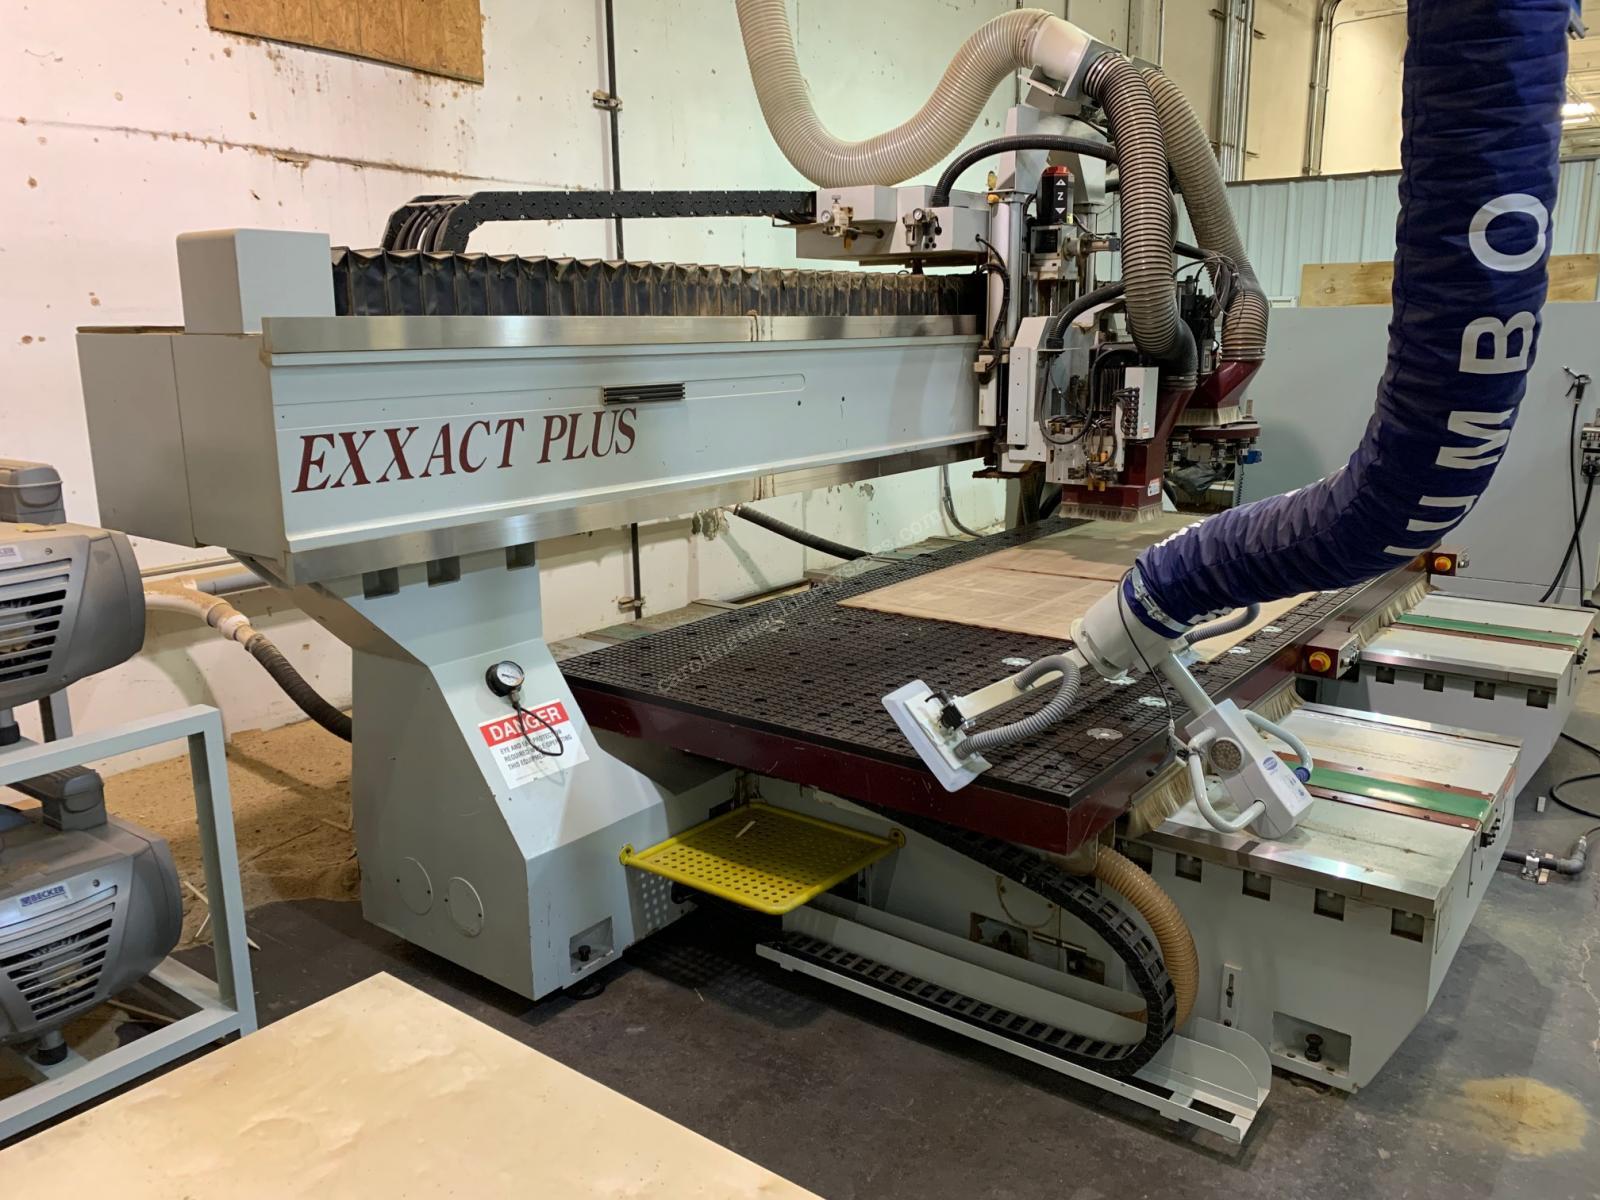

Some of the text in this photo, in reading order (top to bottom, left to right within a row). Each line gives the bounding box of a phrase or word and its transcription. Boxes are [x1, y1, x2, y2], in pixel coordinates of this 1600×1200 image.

[1057, 191, 1064, 201] Z
[291, 407, 636, 493] EXXACT PLUS
[489, 706, 562, 740] DANGER
[31, 885, 66, 900] BECKER
